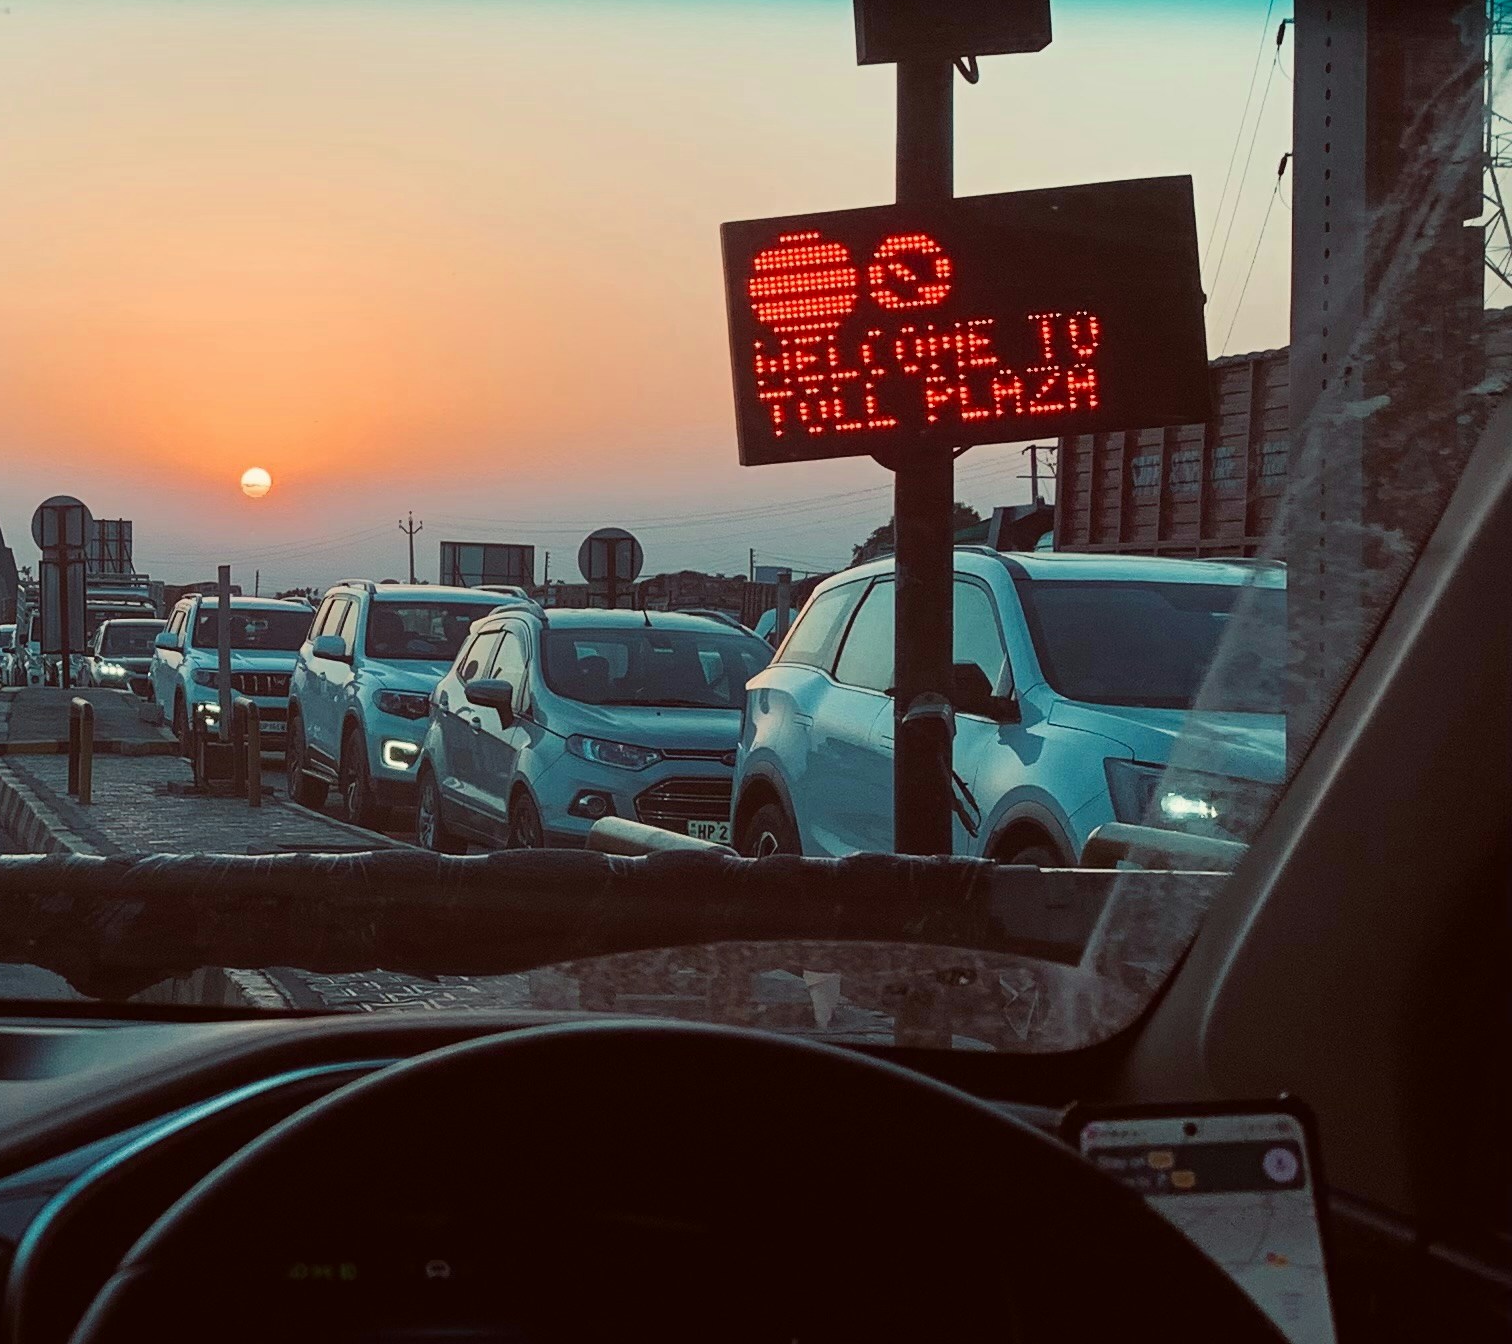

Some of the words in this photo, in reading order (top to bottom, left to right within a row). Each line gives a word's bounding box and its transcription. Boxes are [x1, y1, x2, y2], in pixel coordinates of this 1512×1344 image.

[754, 318, 997, 386] WELCOME
[1027, 310, 1102, 361] TO
[758, 384, 898, 439] TOLL
[924, 362, 1101, 424] PLAZA
[697, 824, 715, 839] HP
